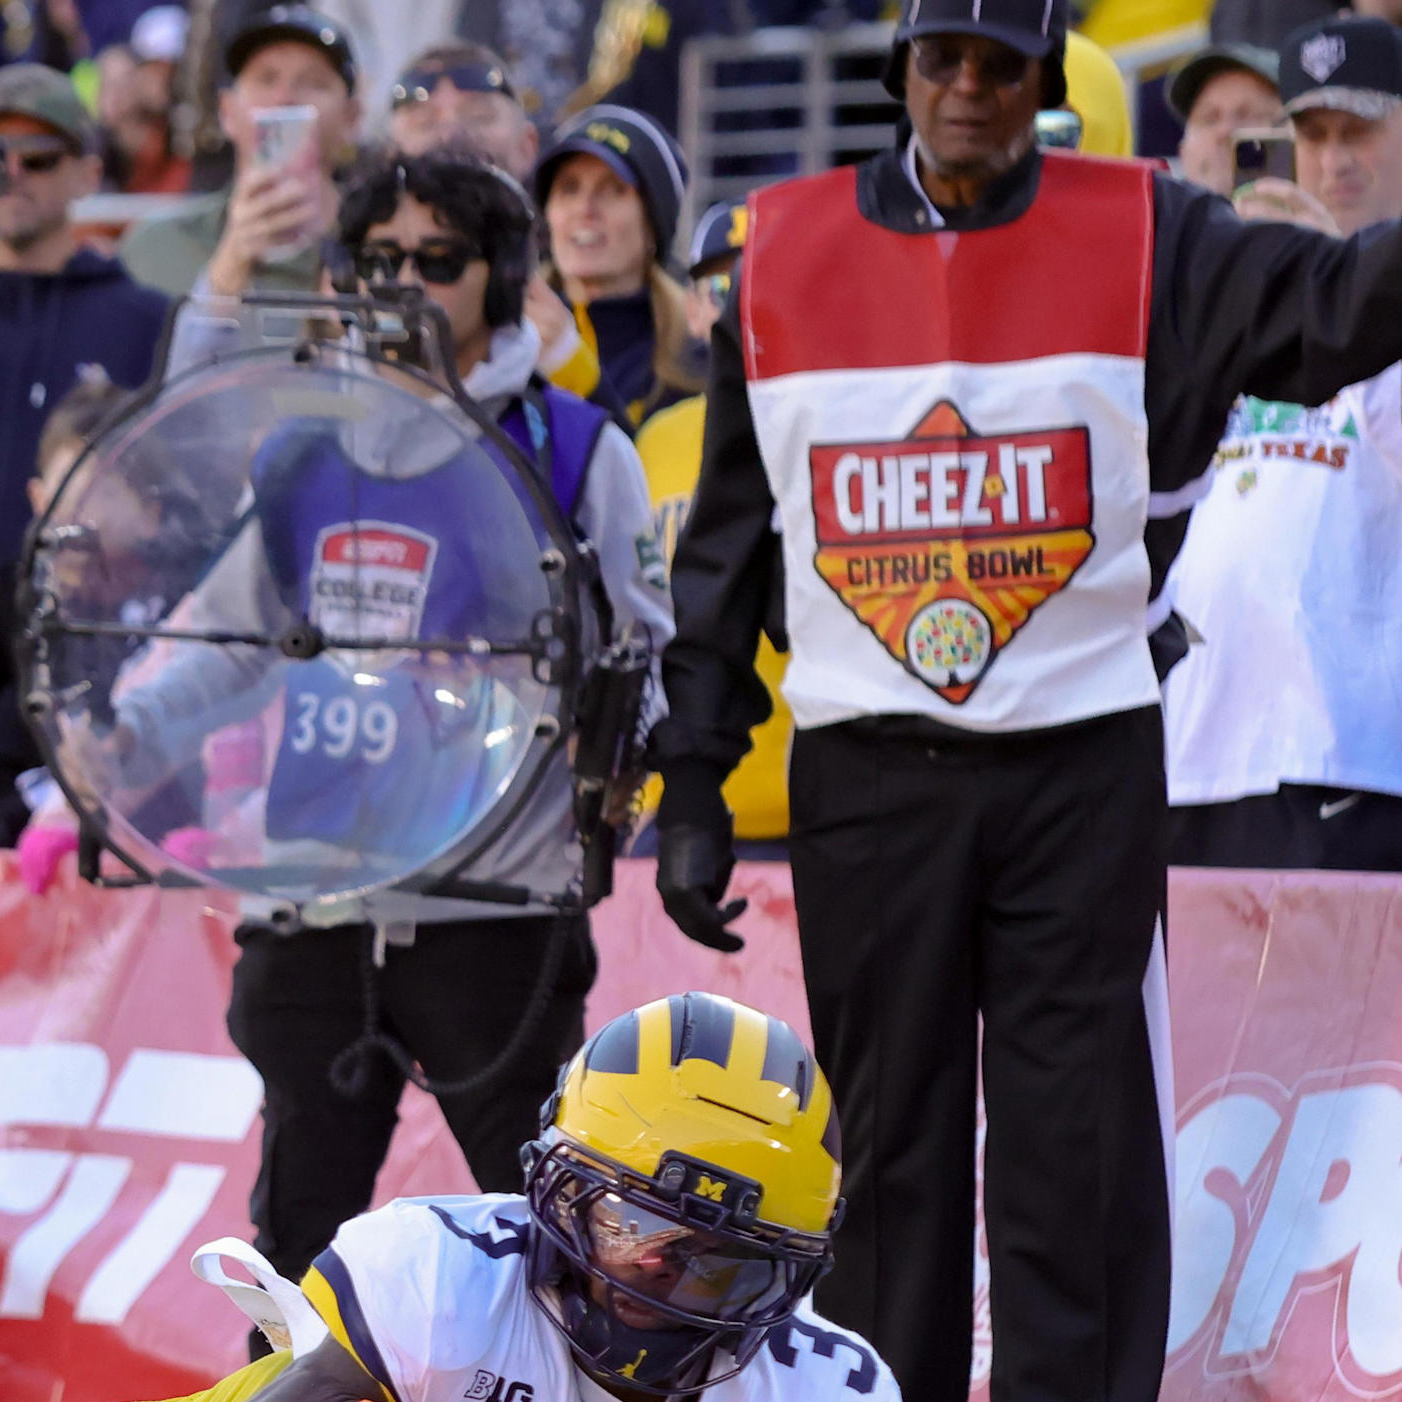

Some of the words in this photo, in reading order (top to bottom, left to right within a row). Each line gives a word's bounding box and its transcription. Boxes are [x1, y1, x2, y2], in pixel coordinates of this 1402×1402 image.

[1261, 441, 1349, 472] TEXAS
[847, 552, 953, 586] CITRUS
[966, 545, 1056, 580] BOWL
[291, 691, 398, 765] 399
[694, 1175, 727, 1202] M
[1166, 1083, 1402, 1376] SP
[768, 1314, 877, 1395] 3
